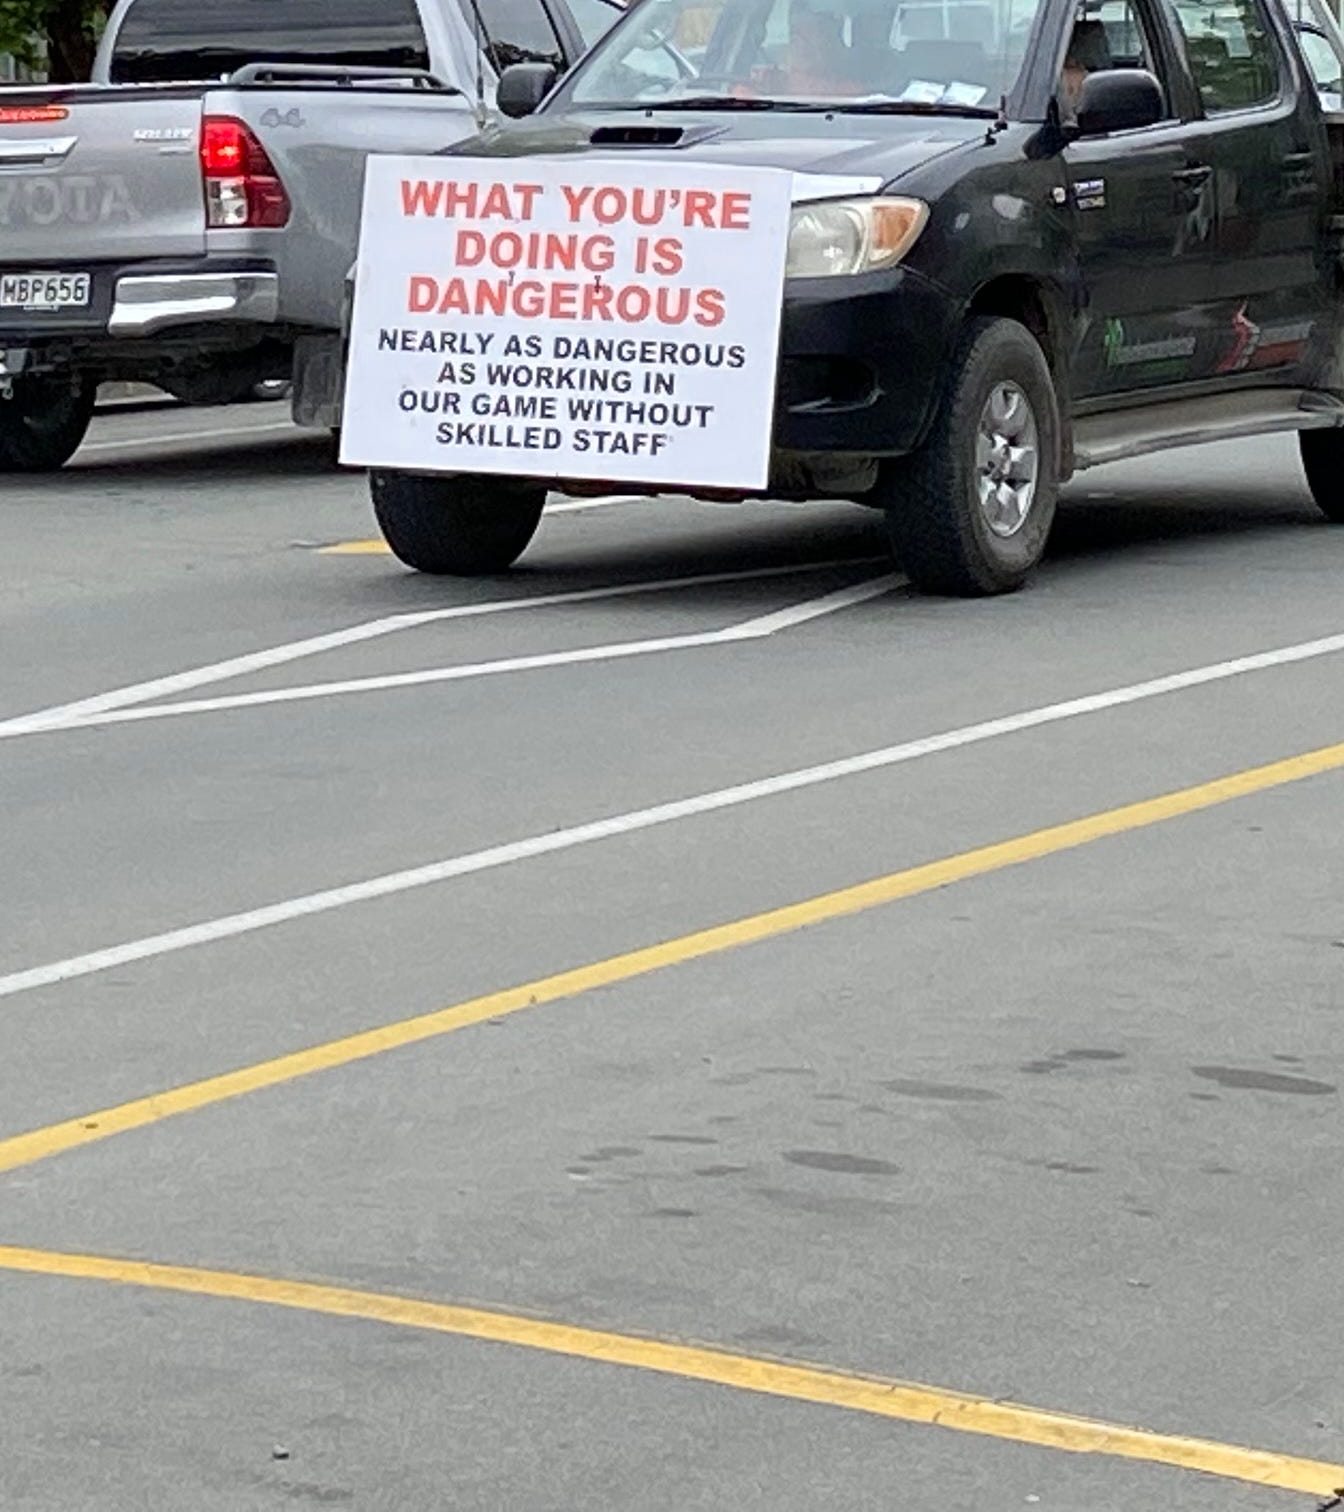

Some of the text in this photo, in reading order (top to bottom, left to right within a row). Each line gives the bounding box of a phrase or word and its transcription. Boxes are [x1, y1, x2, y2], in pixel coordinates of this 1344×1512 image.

[401, 180, 751, 229] WHAT YOU'RE
[456, 230, 683, 276] DOING IS
[4, 277, 86, 302] MBP656
[409, 276, 725, 327] DANGEROUS
[378, 328, 746, 368] NEARLY AS DANGEROUS
[438, 362, 676, 396] AS WORKING IN
[399, 390, 714, 427] OUR GAME WITHOUT
[436, 423, 668, 455] SKILLED STAFF
